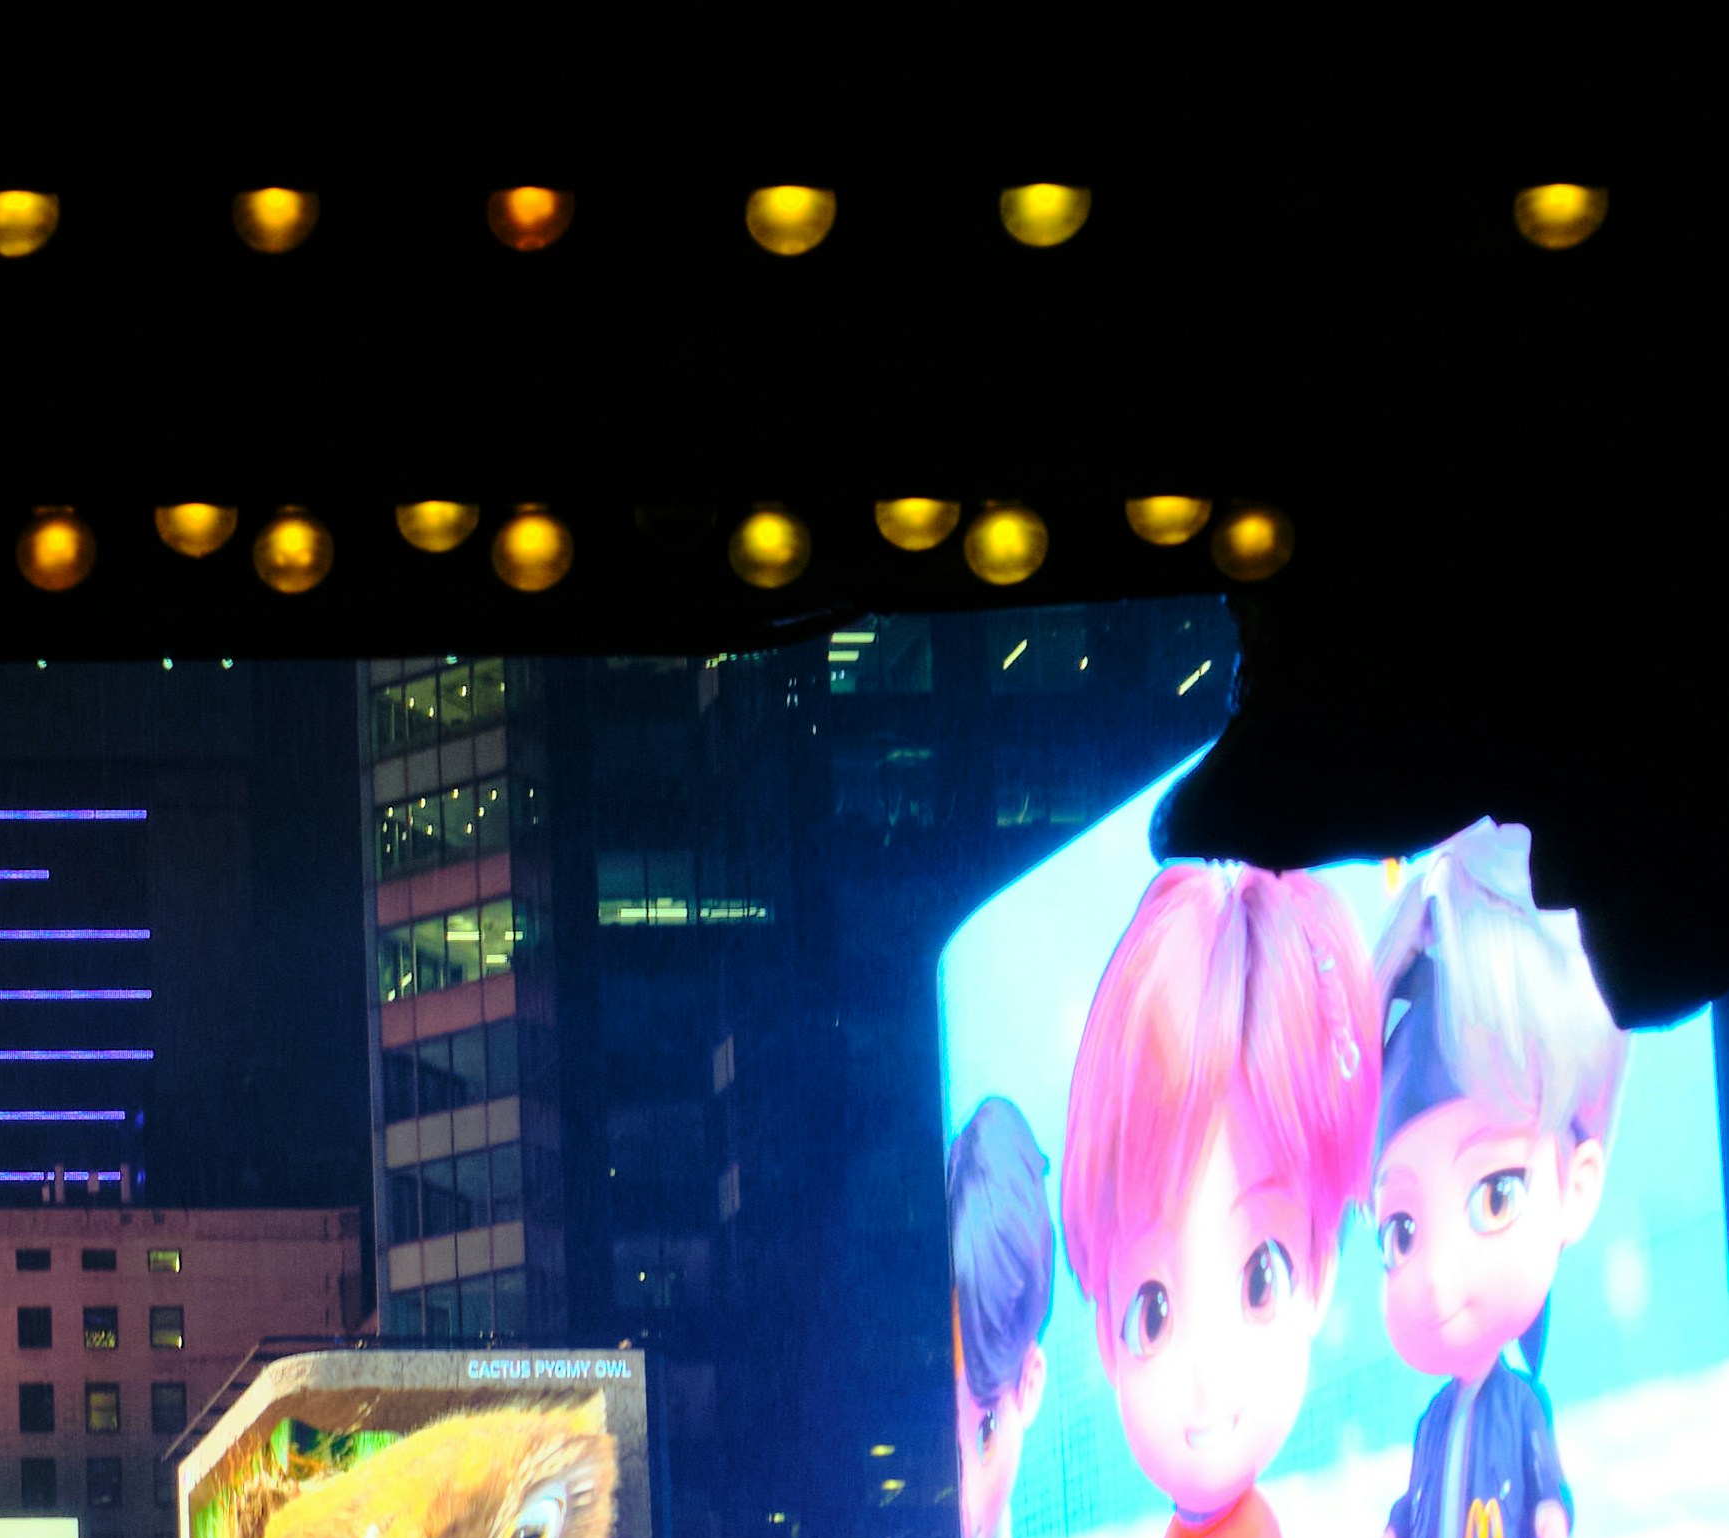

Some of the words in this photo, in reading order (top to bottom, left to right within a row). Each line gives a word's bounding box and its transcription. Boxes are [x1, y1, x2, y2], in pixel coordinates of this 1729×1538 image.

[468, 1359, 530, 1379] CACTUS
[535, 1359, 591, 1379] PYGMY
[595, 1359, 631, 1379] OWL
